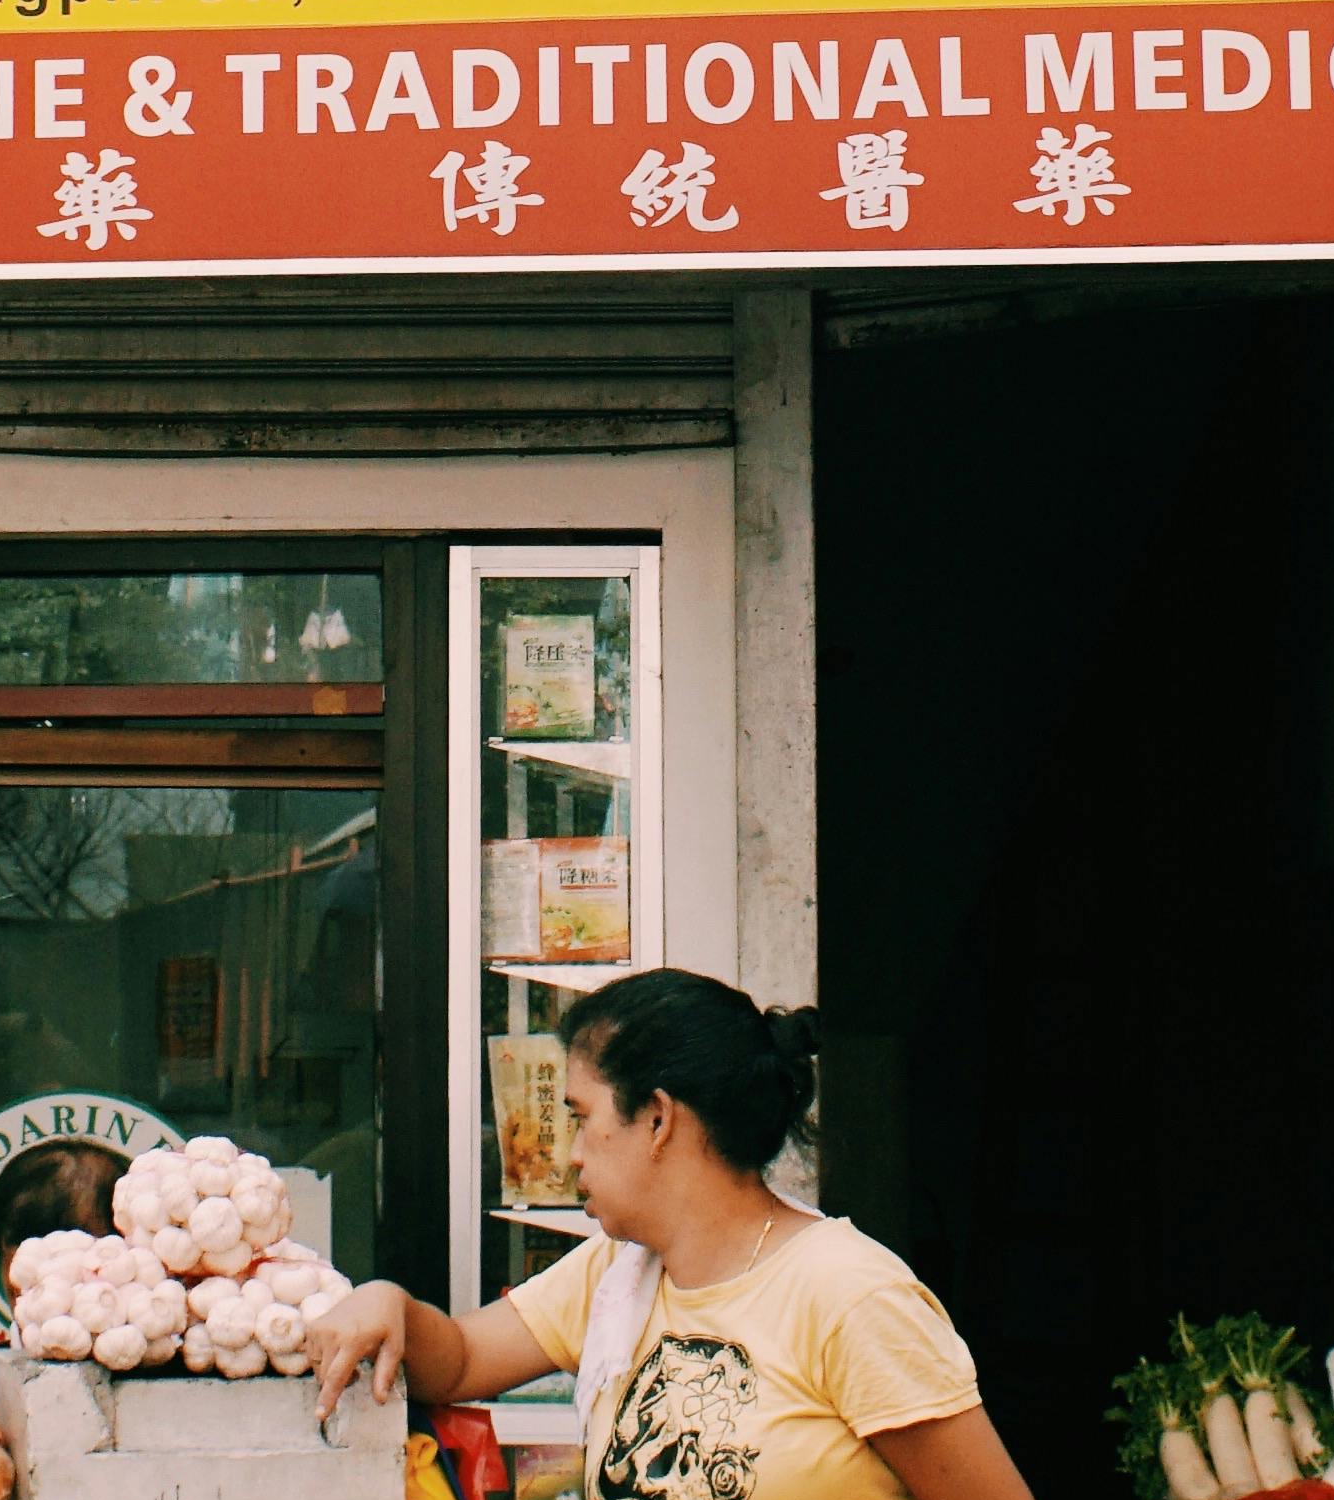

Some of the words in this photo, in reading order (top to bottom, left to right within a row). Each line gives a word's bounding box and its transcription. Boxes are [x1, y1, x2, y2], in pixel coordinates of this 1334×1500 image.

[123, 54, 195, 137] &
[225, 33, 991, 134] TRADITIONAL
[430, 126, 1133, 236] 傳統醫藥
